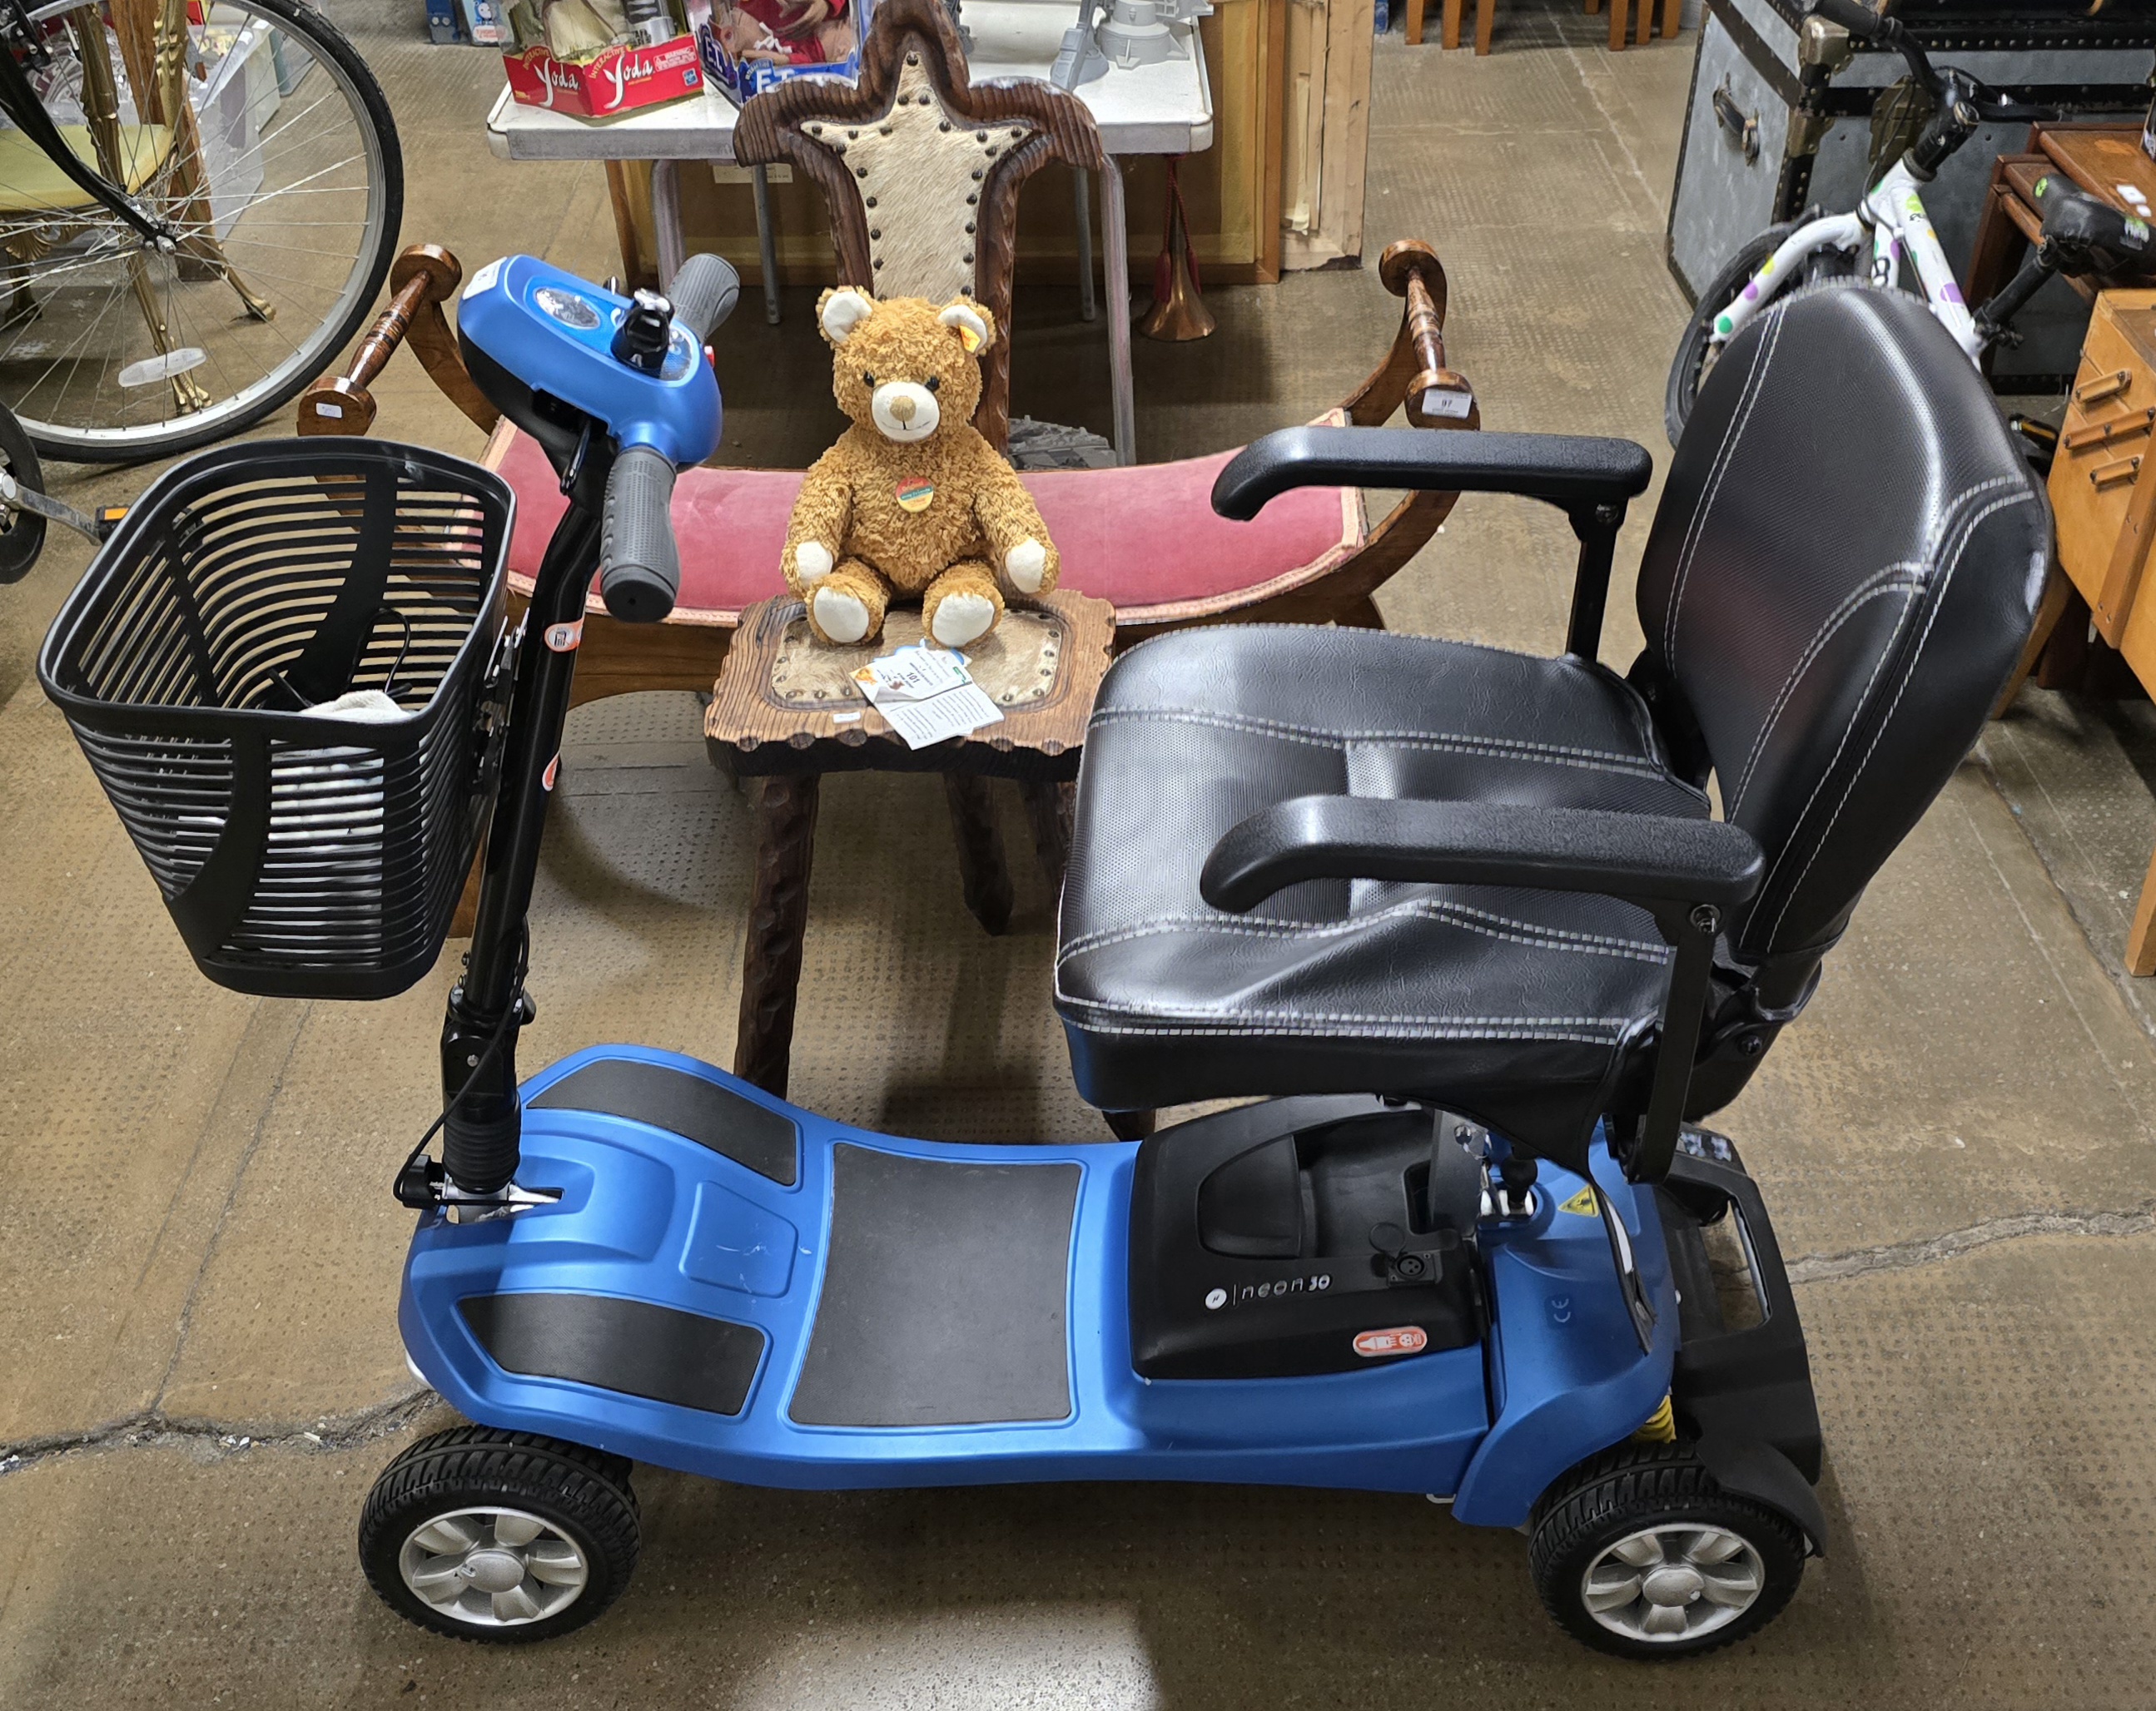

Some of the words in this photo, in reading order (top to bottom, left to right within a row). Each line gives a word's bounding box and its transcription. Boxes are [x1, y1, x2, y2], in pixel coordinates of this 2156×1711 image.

[533, 57, 579, 107] Yoda
[589, 47, 625, 79] INTERACTIVE
[602, 53, 654, 109] Yoda
